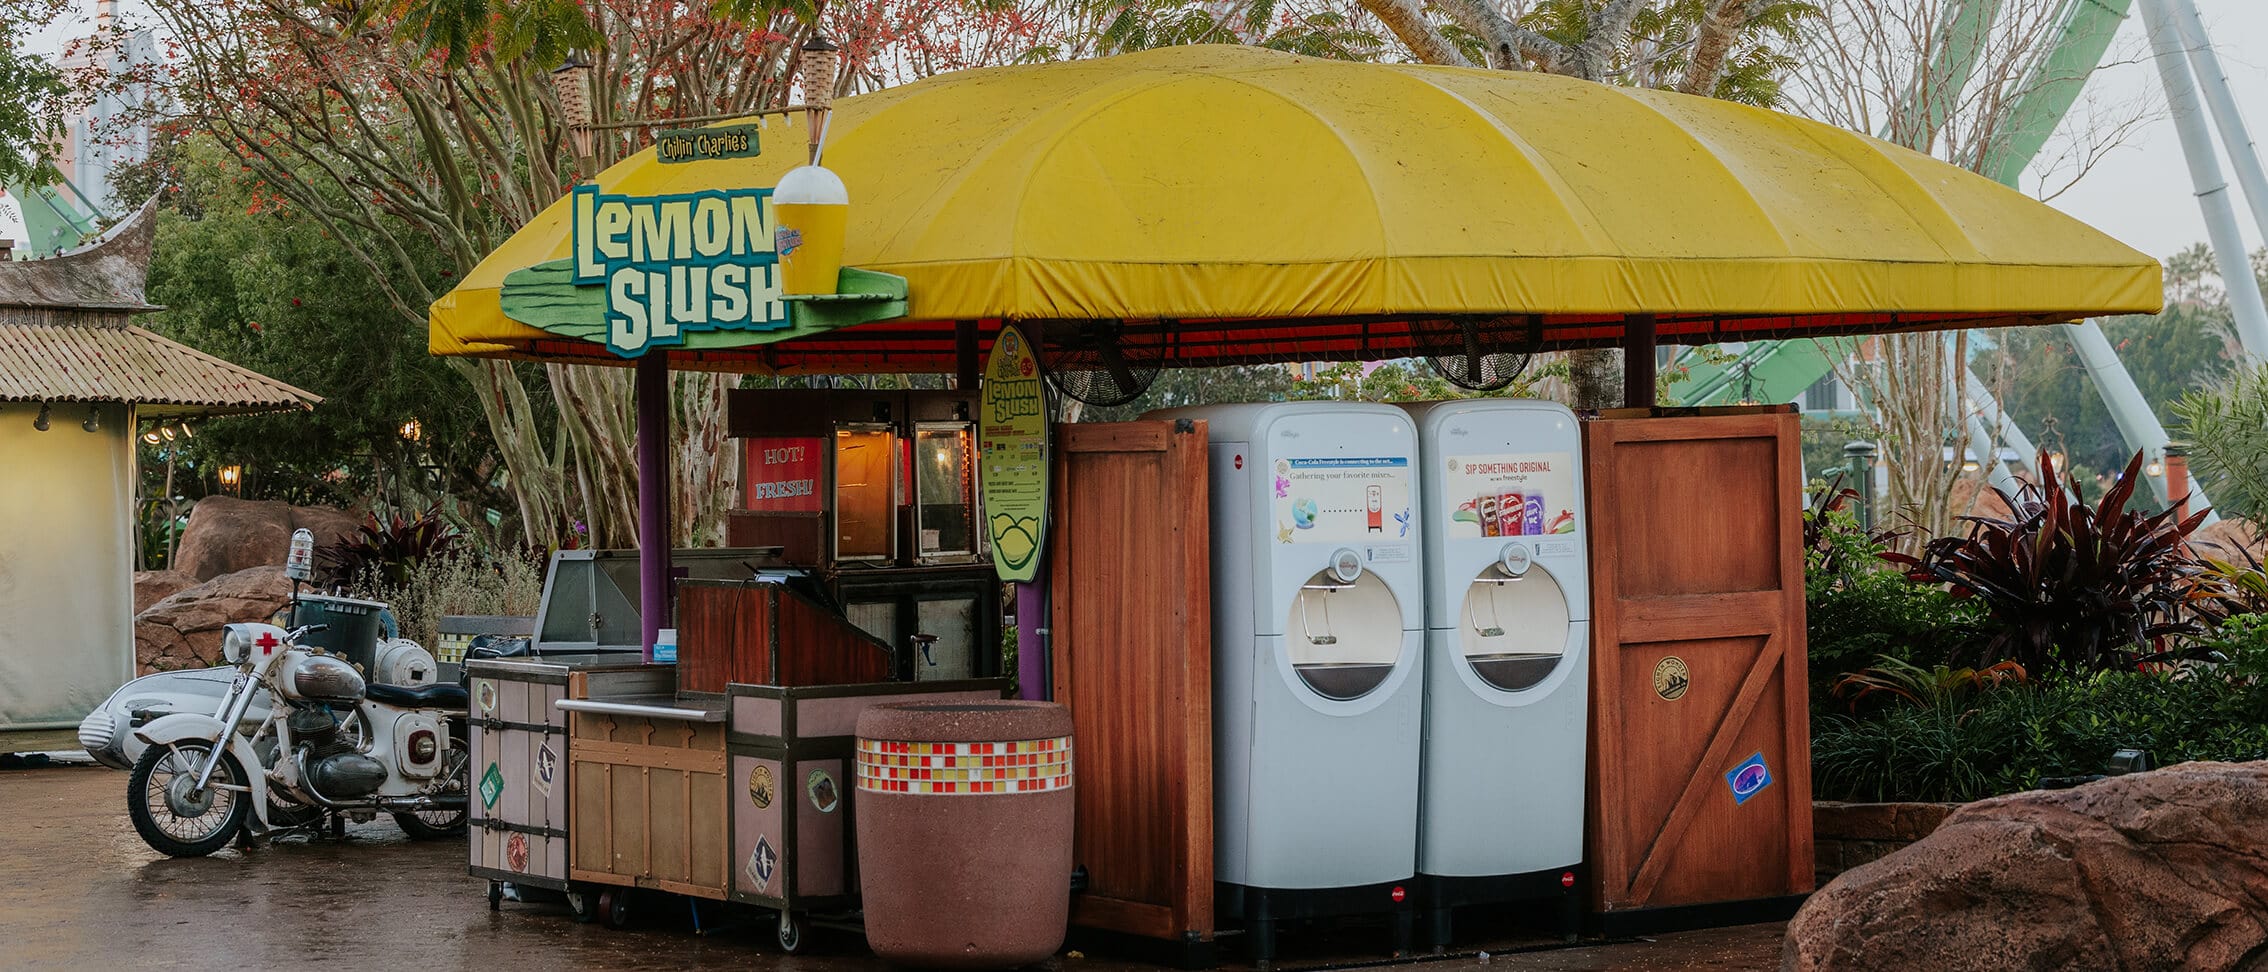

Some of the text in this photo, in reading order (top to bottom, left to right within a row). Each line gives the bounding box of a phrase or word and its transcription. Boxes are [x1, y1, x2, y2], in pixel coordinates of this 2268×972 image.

[662, 129, 748, 158] Chillin' Charlie's
[764, 447, 805, 464] HOT!
[1289, 472, 1325, 480] Gathering
[1326, 472, 1342, 480] your
[1343, 471, 1370, 479] favorite
[1465, 461, 1551, 475] SIP SOMETHING ORIGINAL
[755, 479, 813, 500] FRESH!
